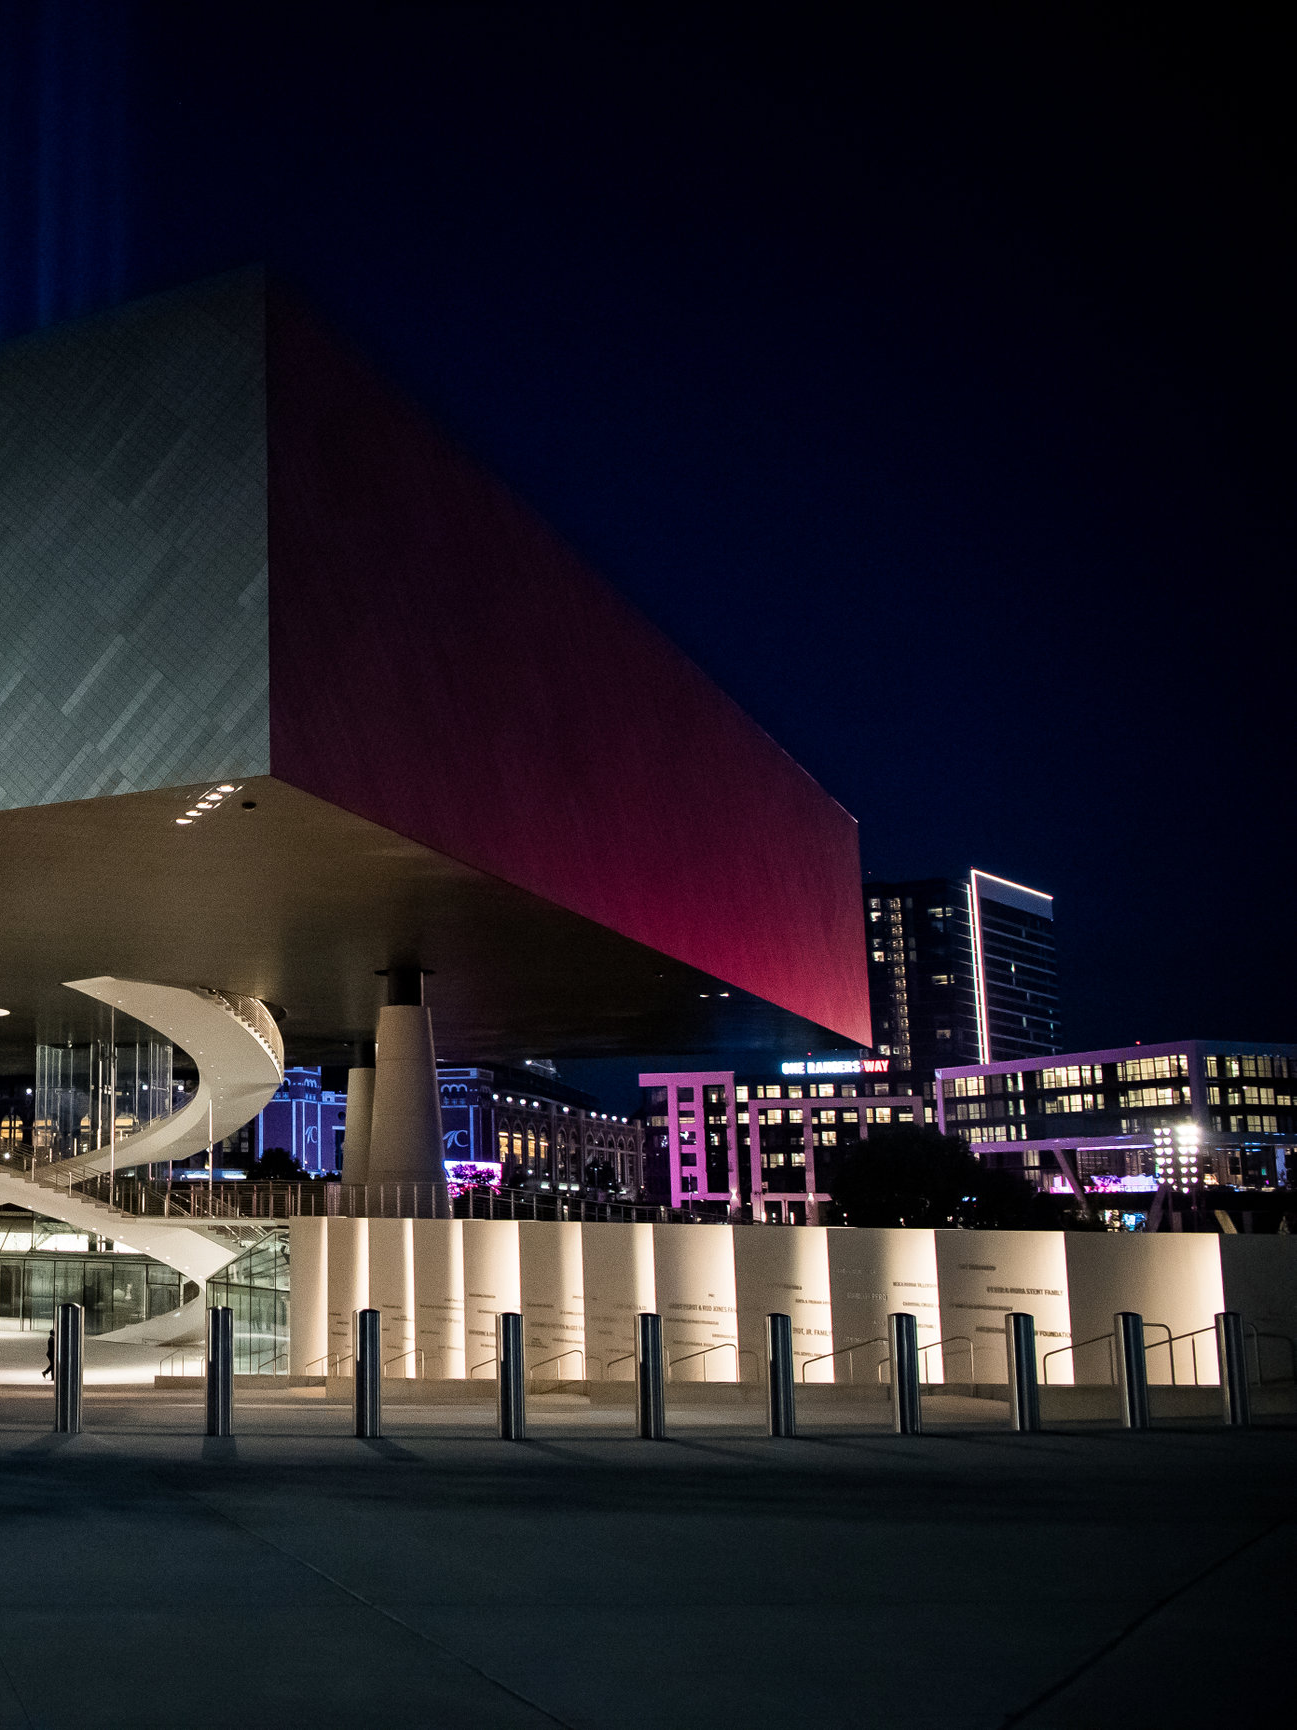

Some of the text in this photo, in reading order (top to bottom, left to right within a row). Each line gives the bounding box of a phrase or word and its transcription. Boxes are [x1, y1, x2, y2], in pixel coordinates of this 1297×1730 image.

[782, 1059, 889, 1074] ONE RANGERS WAY
